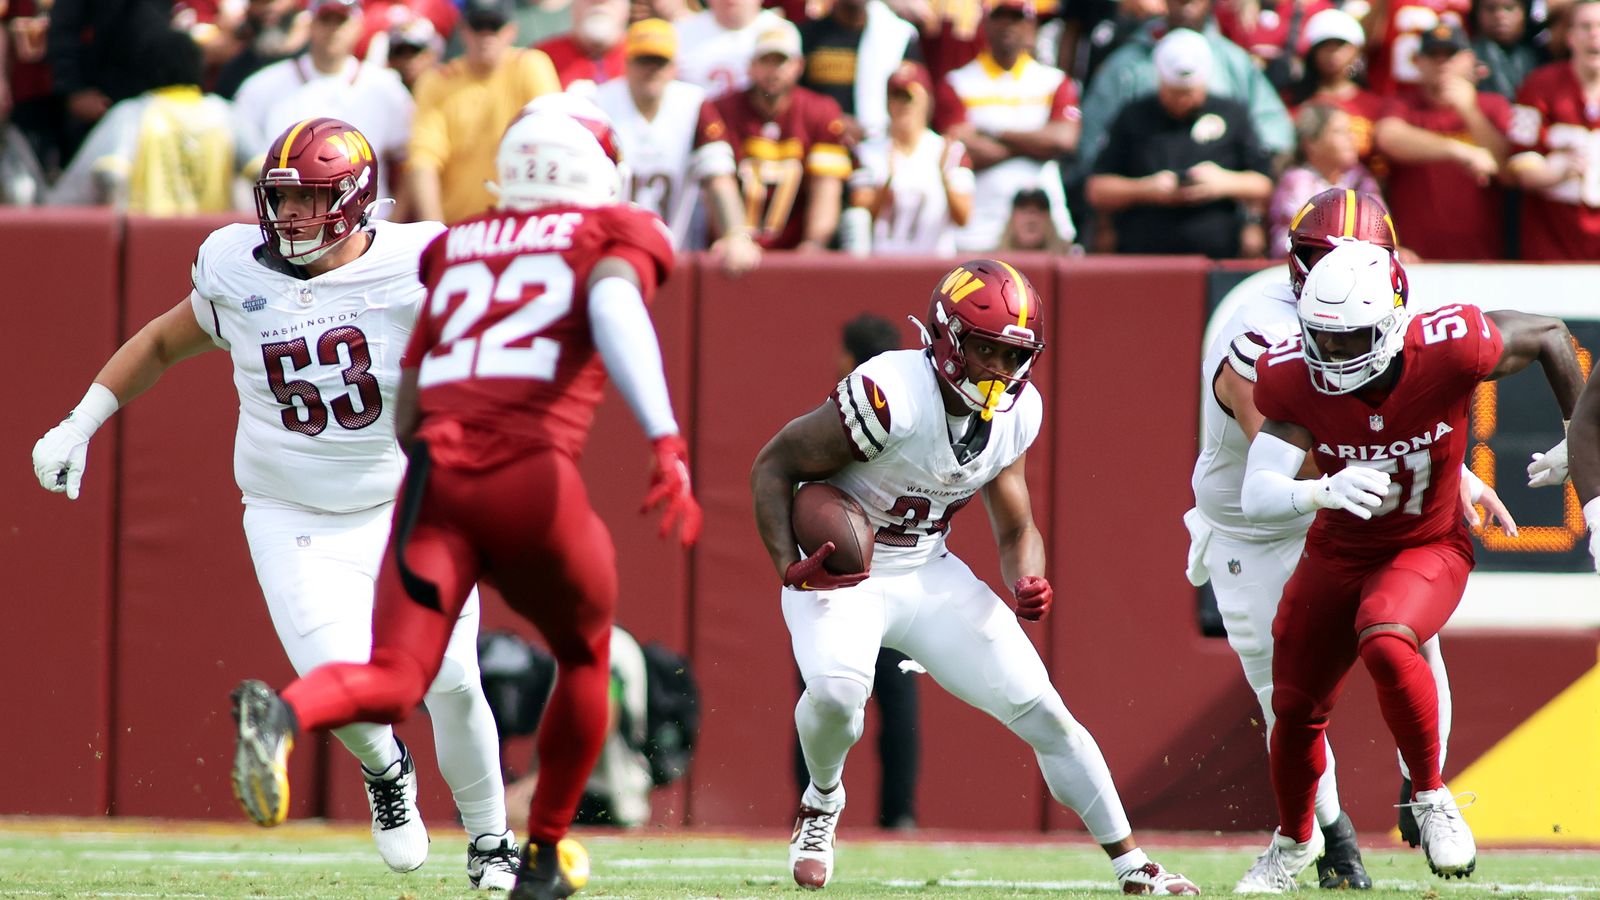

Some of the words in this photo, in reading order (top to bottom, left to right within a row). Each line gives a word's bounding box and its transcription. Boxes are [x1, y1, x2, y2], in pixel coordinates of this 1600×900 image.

[738, 157, 803, 237] 17
[446, 212, 583, 262] WALLACE
[261, 311, 359, 338] WASHINGTON
[418, 252, 576, 390] 22
[1421, 305, 1468, 345] 51
[261, 325, 383, 437] 53
[1317, 421, 1454, 461] ARIZONA
